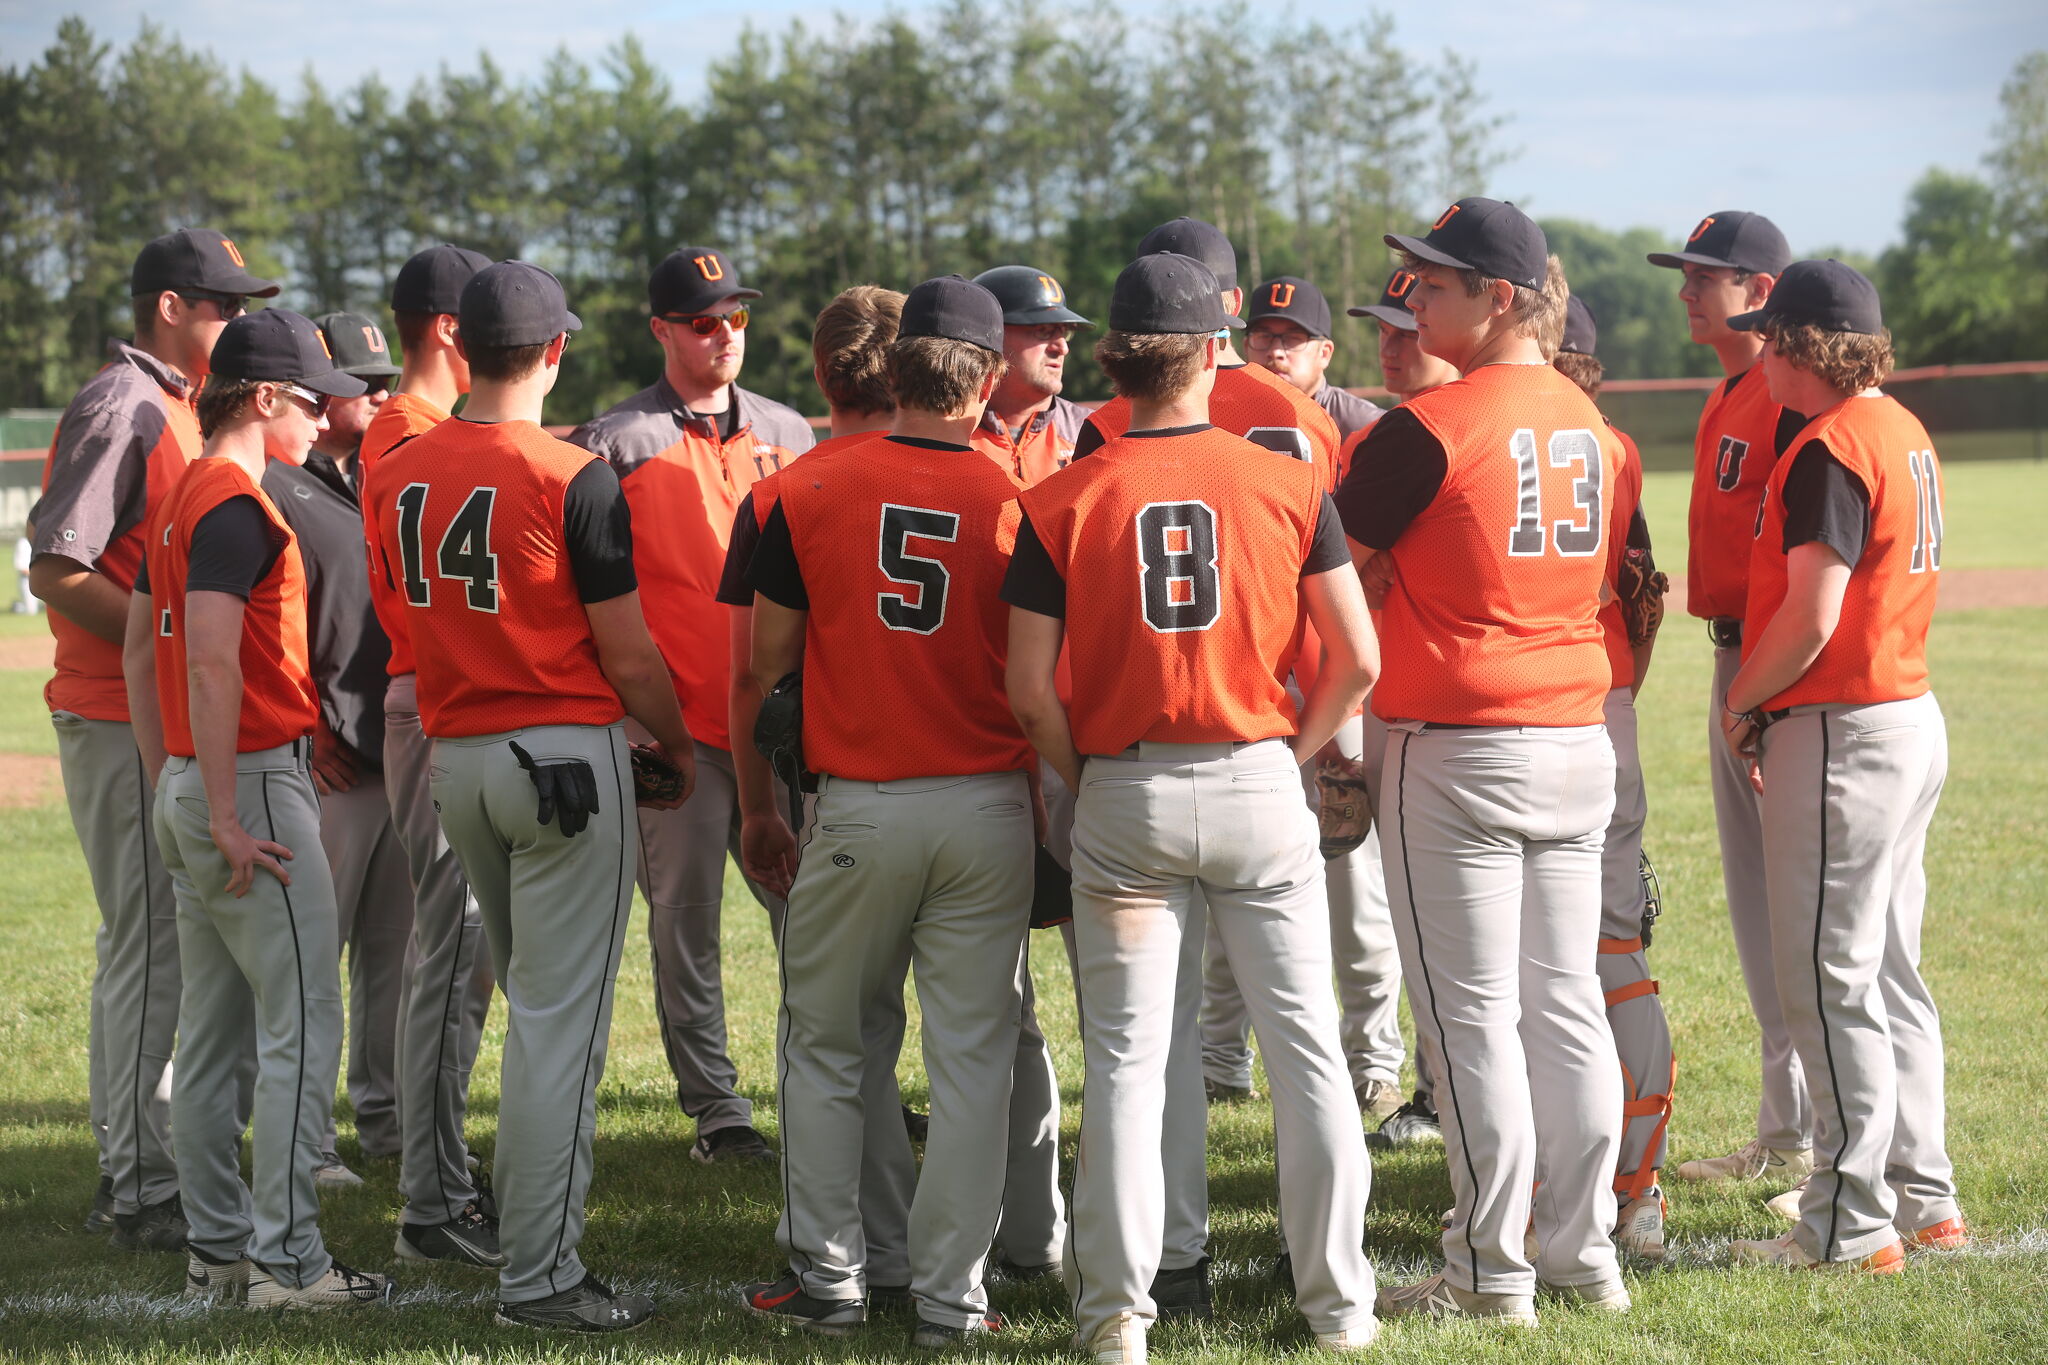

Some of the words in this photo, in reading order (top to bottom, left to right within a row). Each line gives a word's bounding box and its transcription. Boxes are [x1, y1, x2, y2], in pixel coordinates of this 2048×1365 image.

[693, 254, 723, 282] U
[1039, 276, 1062, 303] U
[1270, 283, 1296, 308] U
[1387, 271, 1416, 297] U
[362, 326, 385, 353] U
[1715, 434, 1749, 492] U
[1507, 428, 1603, 557] 13
[1908, 449, 1943, 574] 11
[395, 482, 499, 614] 14
[877, 502, 961, 636] 5
[1135, 500, 1221, 634] 8
